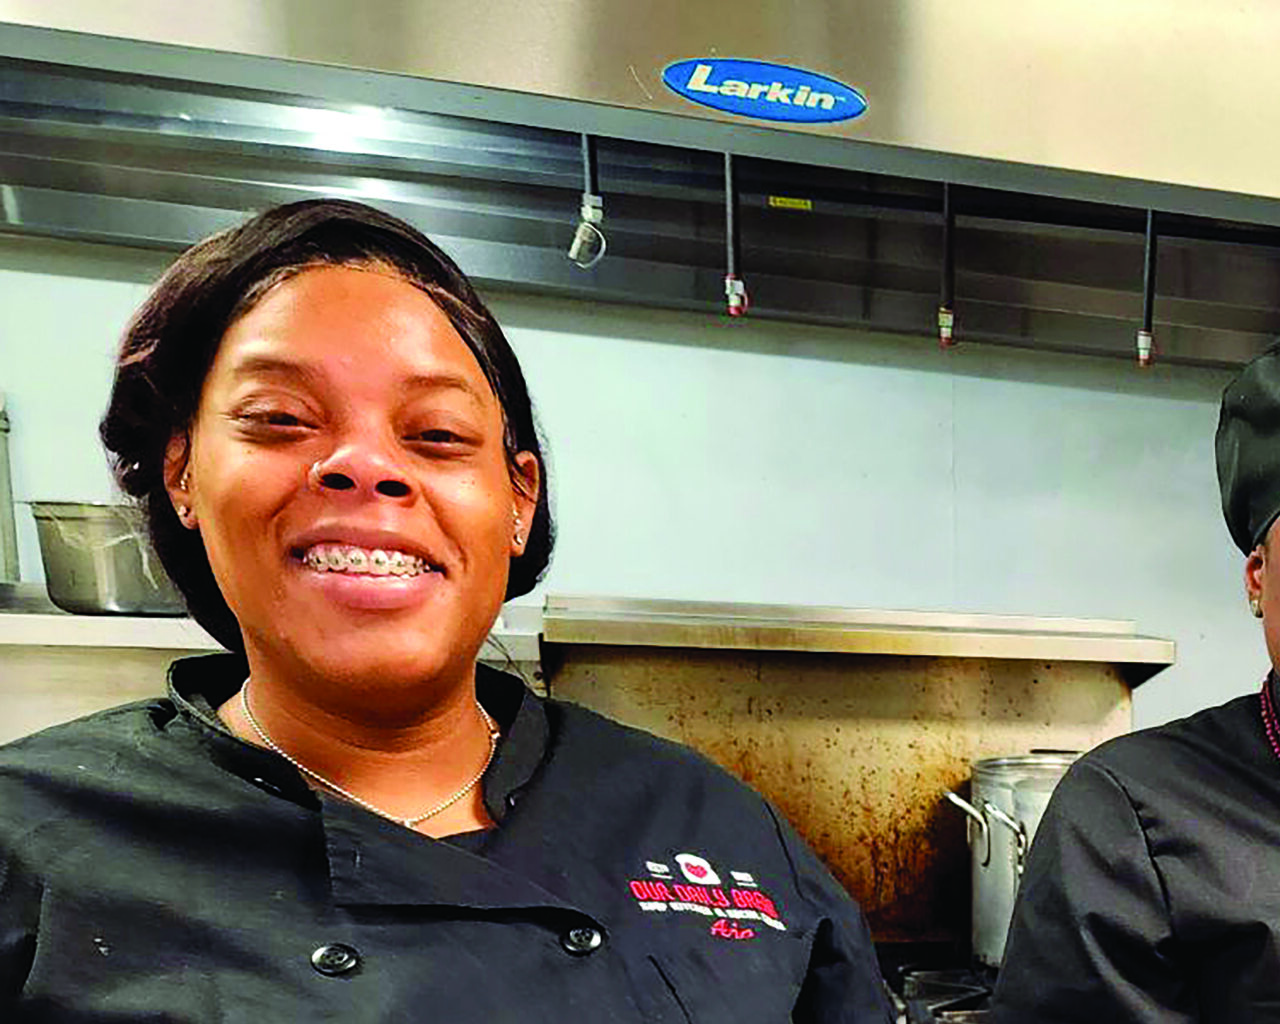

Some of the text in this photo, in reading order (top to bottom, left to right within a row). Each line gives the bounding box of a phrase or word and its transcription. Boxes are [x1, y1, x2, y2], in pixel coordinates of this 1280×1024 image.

[686, 63, 838, 110] Larkin
[629, 880, 674, 901] OUR
[673, 884, 731, 908] DAILY
